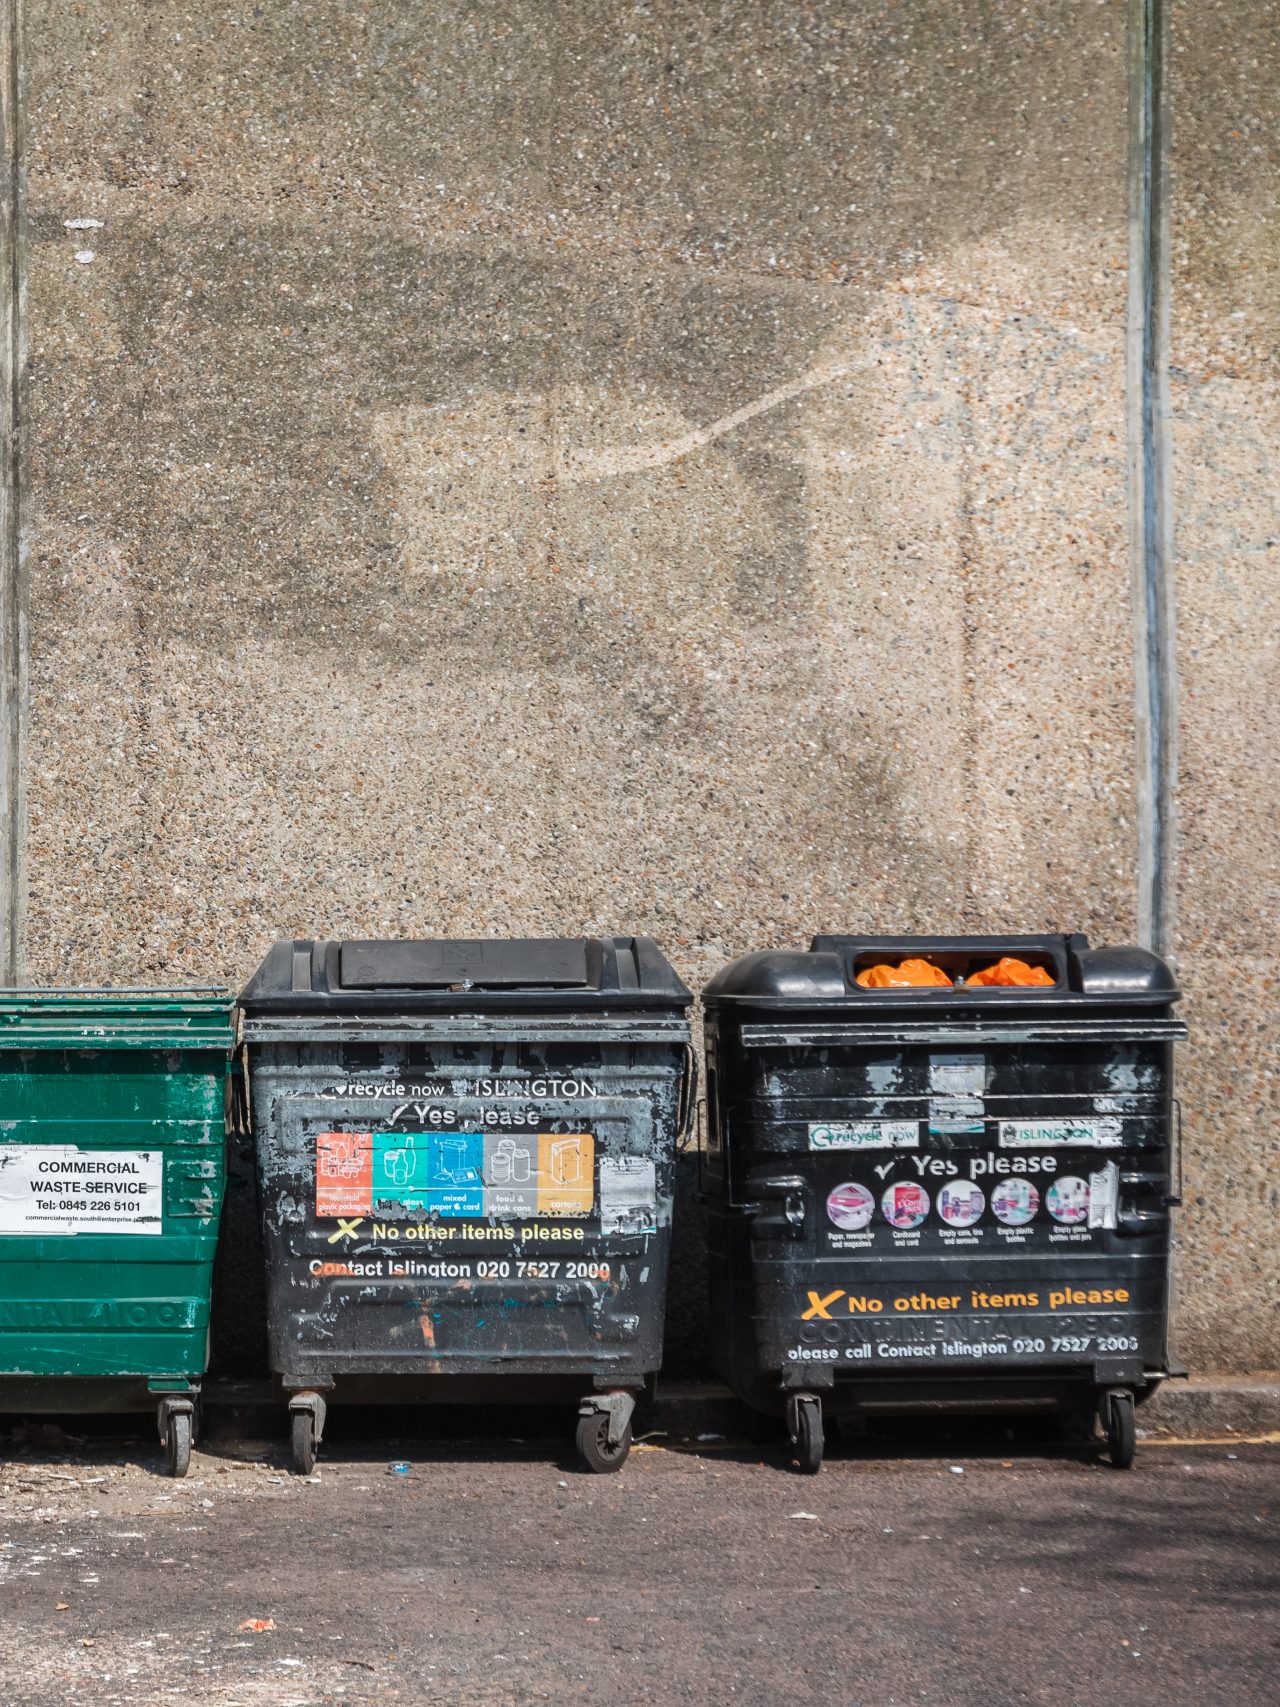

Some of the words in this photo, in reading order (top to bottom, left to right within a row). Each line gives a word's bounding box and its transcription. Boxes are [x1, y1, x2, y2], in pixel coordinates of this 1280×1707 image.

[348, 1080, 405, 1099] recycle
[410, 1086, 445, 1096] now
[414, 1105, 456, 1124] Yes
[463, 1106, 540, 1128] lease
[888, 1130, 916, 1142] now
[38, 1161, 140, 1174] COMMERCIAL
[911, 1155, 959, 1176] Yes
[969, 1151, 1058, 1180] please
[30, 1181, 81, 1193] WASTE
[85, 1181, 148, 1194] SERVICE
[36, 1200, 56, 1210] Tel:
[59, 1200, 87, 1211] 0845
[90, 1201, 111, 1211] 226
[114, 1201, 140, 1212] 5101
[430, 1203, 452, 1212] paper
[463, 1203, 481, 1211] card
[443, 1194, 467, 1202] mixed
[372, 1223, 400, 1240] No
[405, 1223, 457, 1240] other
[462, 1223, 515, 1240] items
[521, 1223, 585, 1243] please
[309, 1259, 383, 1276] Contact
[388, 1259, 470, 1277] Islington
[477, 1261, 510, 1278] 020
[516, 1261, 560, 1278] 7527
[566, 1262, 610, 1280] 2000
[849, 1296, 884, 1312] No
[894, 1292, 962, 1312] other
[972, 1290, 1039, 1309] items
[1049, 1287, 1130, 1310] please
[845, 1343, 872, 1359] call
[877, 1343, 937, 1358] Contact
[942, 1340, 1008, 1358] Islington
[1012, 1338, 1046, 1354] 020
[1051, 1337, 1091, 1352] 7527
